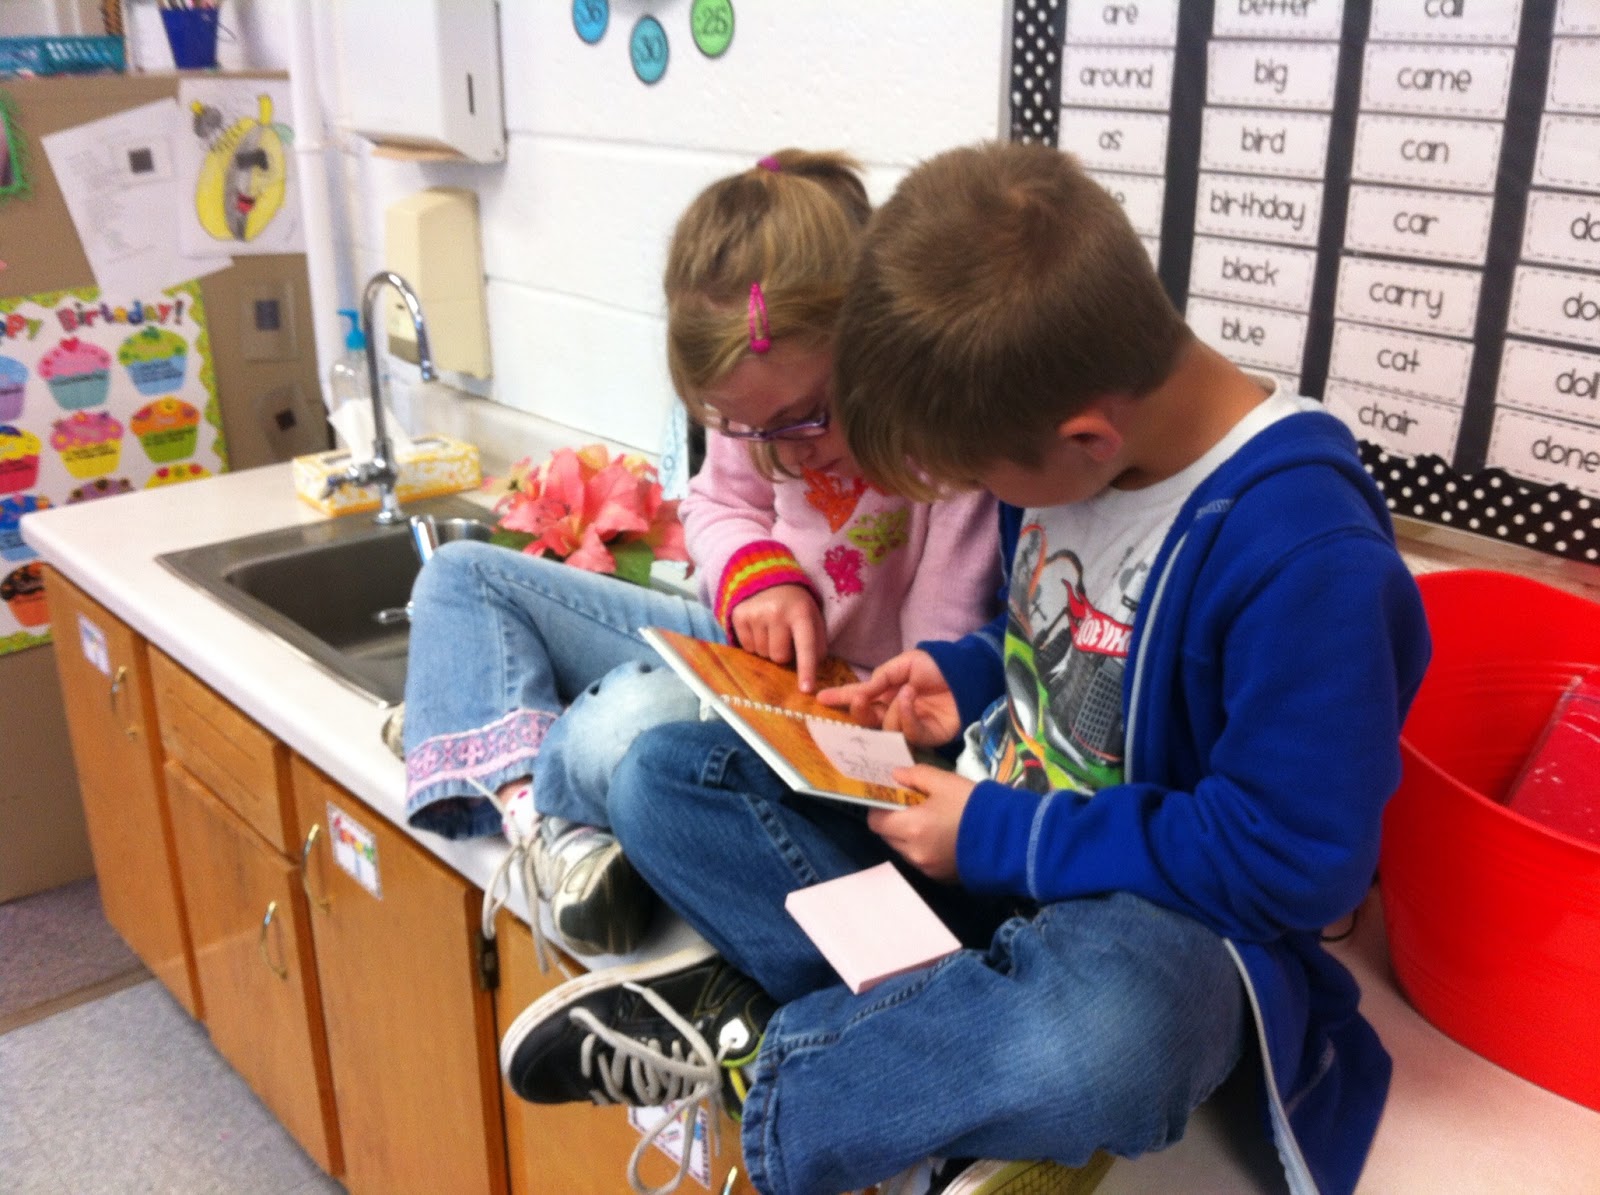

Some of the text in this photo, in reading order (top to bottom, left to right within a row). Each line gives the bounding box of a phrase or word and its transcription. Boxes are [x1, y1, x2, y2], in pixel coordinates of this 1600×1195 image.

[1102, 4, 1139, 25] are
[1080, 65, 1155, 89] around
[1253, 58, 1288, 93] big
[1396, 67, 1472, 92] came
[1098, 129, 1123, 151] as
[1240, 127, 1286, 154] bird
[1400, 139, 1450, 163] can
[1210, 189, 1306, 231] birthday
[1393, 211, 1439, 236] car
[1221, 256, 1280, 286] black
[1368, 282, 1444, 319] carry
[1563, 292, 1600, 321] do
[1220, 317, 1266, 346] blue
[1376, 348, 1420, 373] cat
[1357, 403, 1419, 436] chair
[1531, 436, 1600, 473] done
